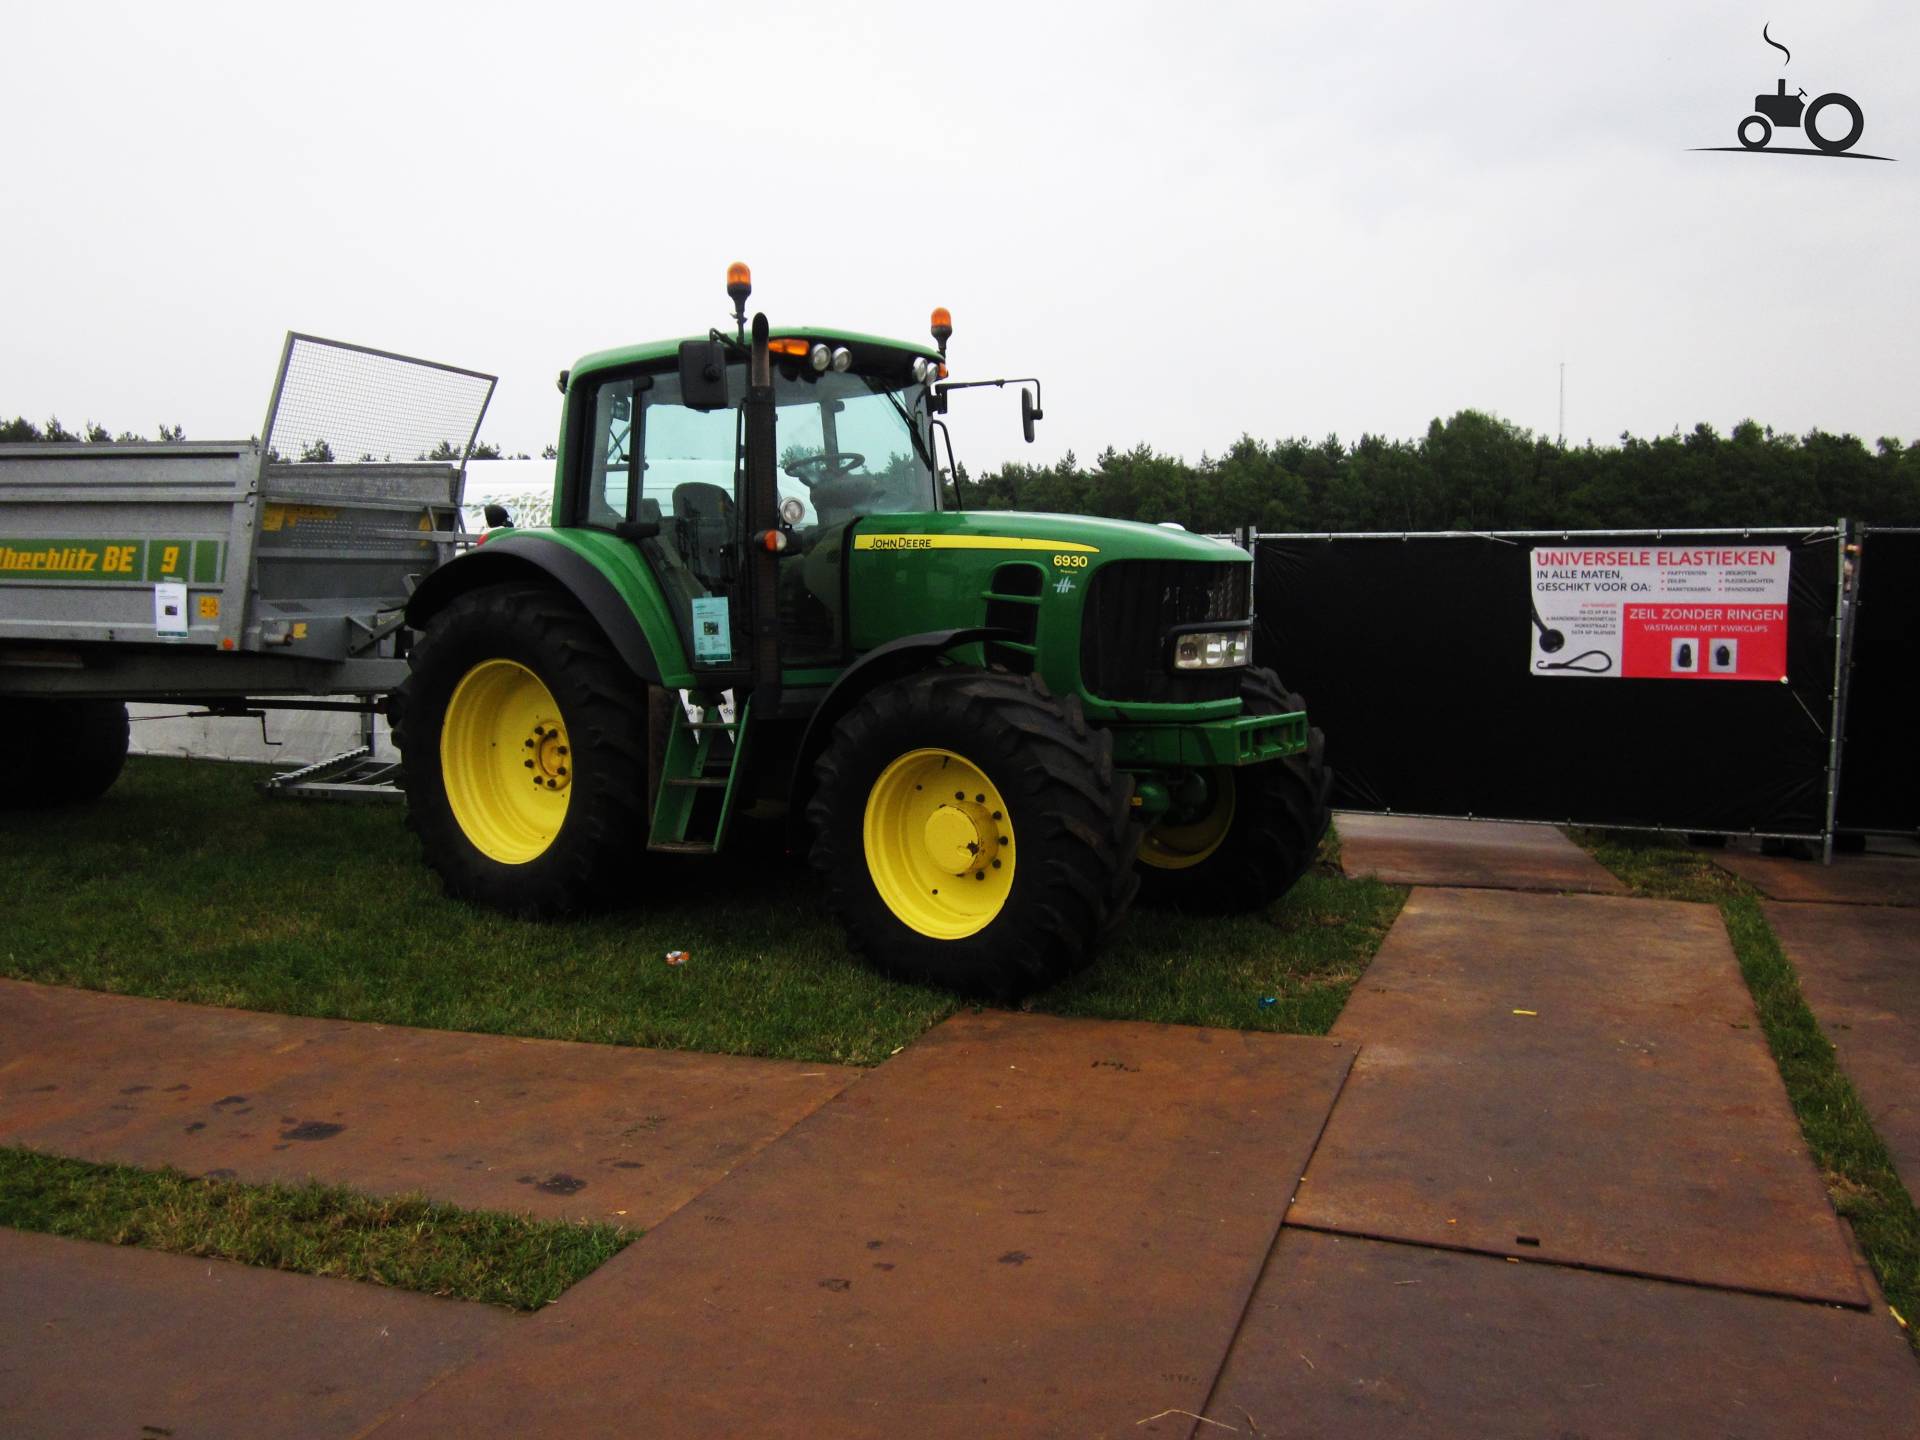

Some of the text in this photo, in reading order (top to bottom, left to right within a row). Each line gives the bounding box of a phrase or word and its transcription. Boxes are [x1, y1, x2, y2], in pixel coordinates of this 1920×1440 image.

[869, 537, 932, 549] JOHN DEERE
[102, 545, 136, 572] BE
[161, 546, 180, 573] 9
[1053, 554, 1088, 568] 6930
[1536, 550, 1776, 566] UNIVERSELE ELASTIEKEN
[1536, 570, 1623, 581] IN ALLE MATEN,
[1536, 583, 1652, 592] GESCHIKT VOOR OA:
[1629, 608, 1658, 620] ZEIL
[1662, 608, 1723, 620] ZONDER
[1727, 608, 1784, 621] RINGEN
[1643, 624, 1698, 632] VASTMAKEN
[1700, 624, 1718, 632] MET
